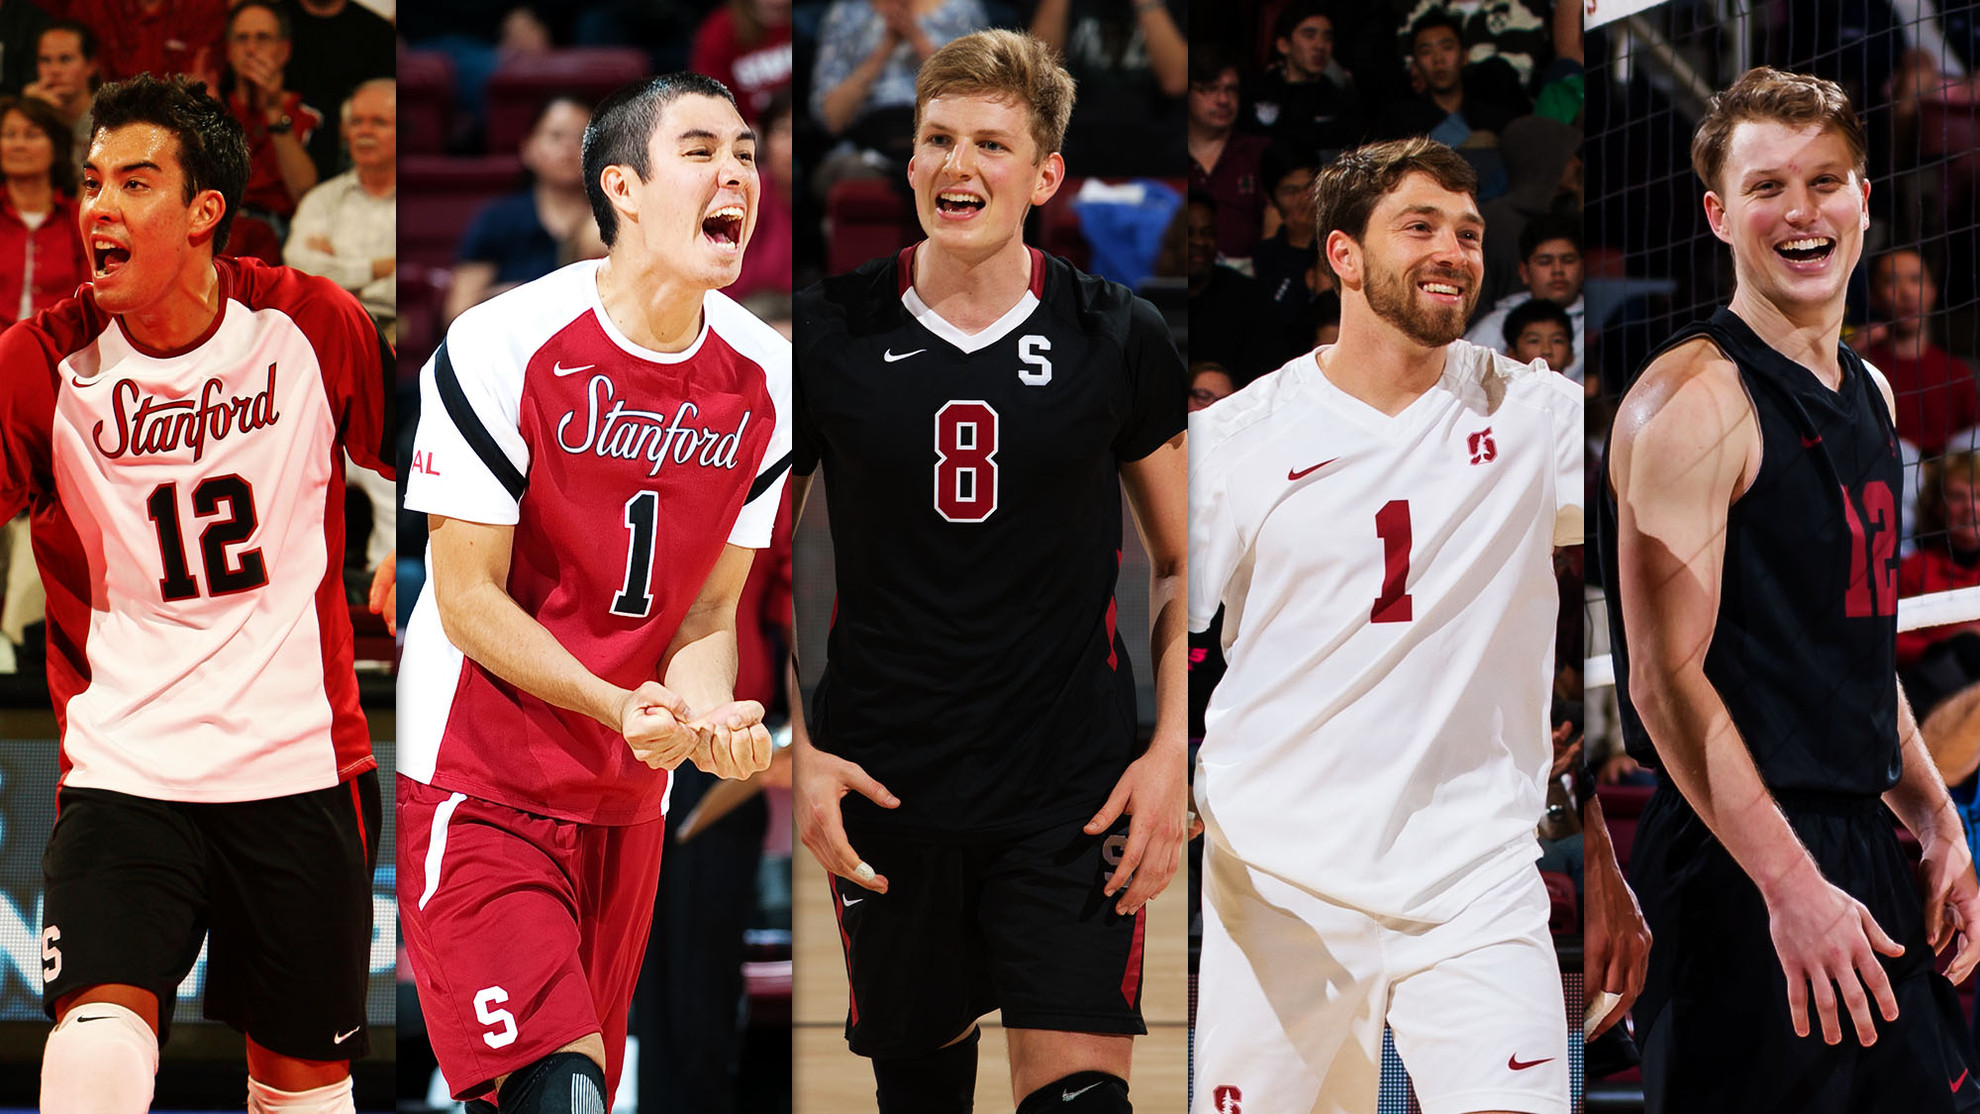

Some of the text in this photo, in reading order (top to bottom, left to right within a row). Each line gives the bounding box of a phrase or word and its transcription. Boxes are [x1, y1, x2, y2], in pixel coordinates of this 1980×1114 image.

[92, 361, 280, 463] Stanford
[1017, 334, 1052, 386] S
[557, 374, 751, 477] Stanford
[934, 400, 999, 523] 8
[146, 473, 269, 602] 12
[609, 489, 659, 618] 1
[1370, 499, 1413, 624] 1
[1841, 480, 1898, 618] 12
[41, 925, 63, 983] S
[473, 985, 519, 1049] S
